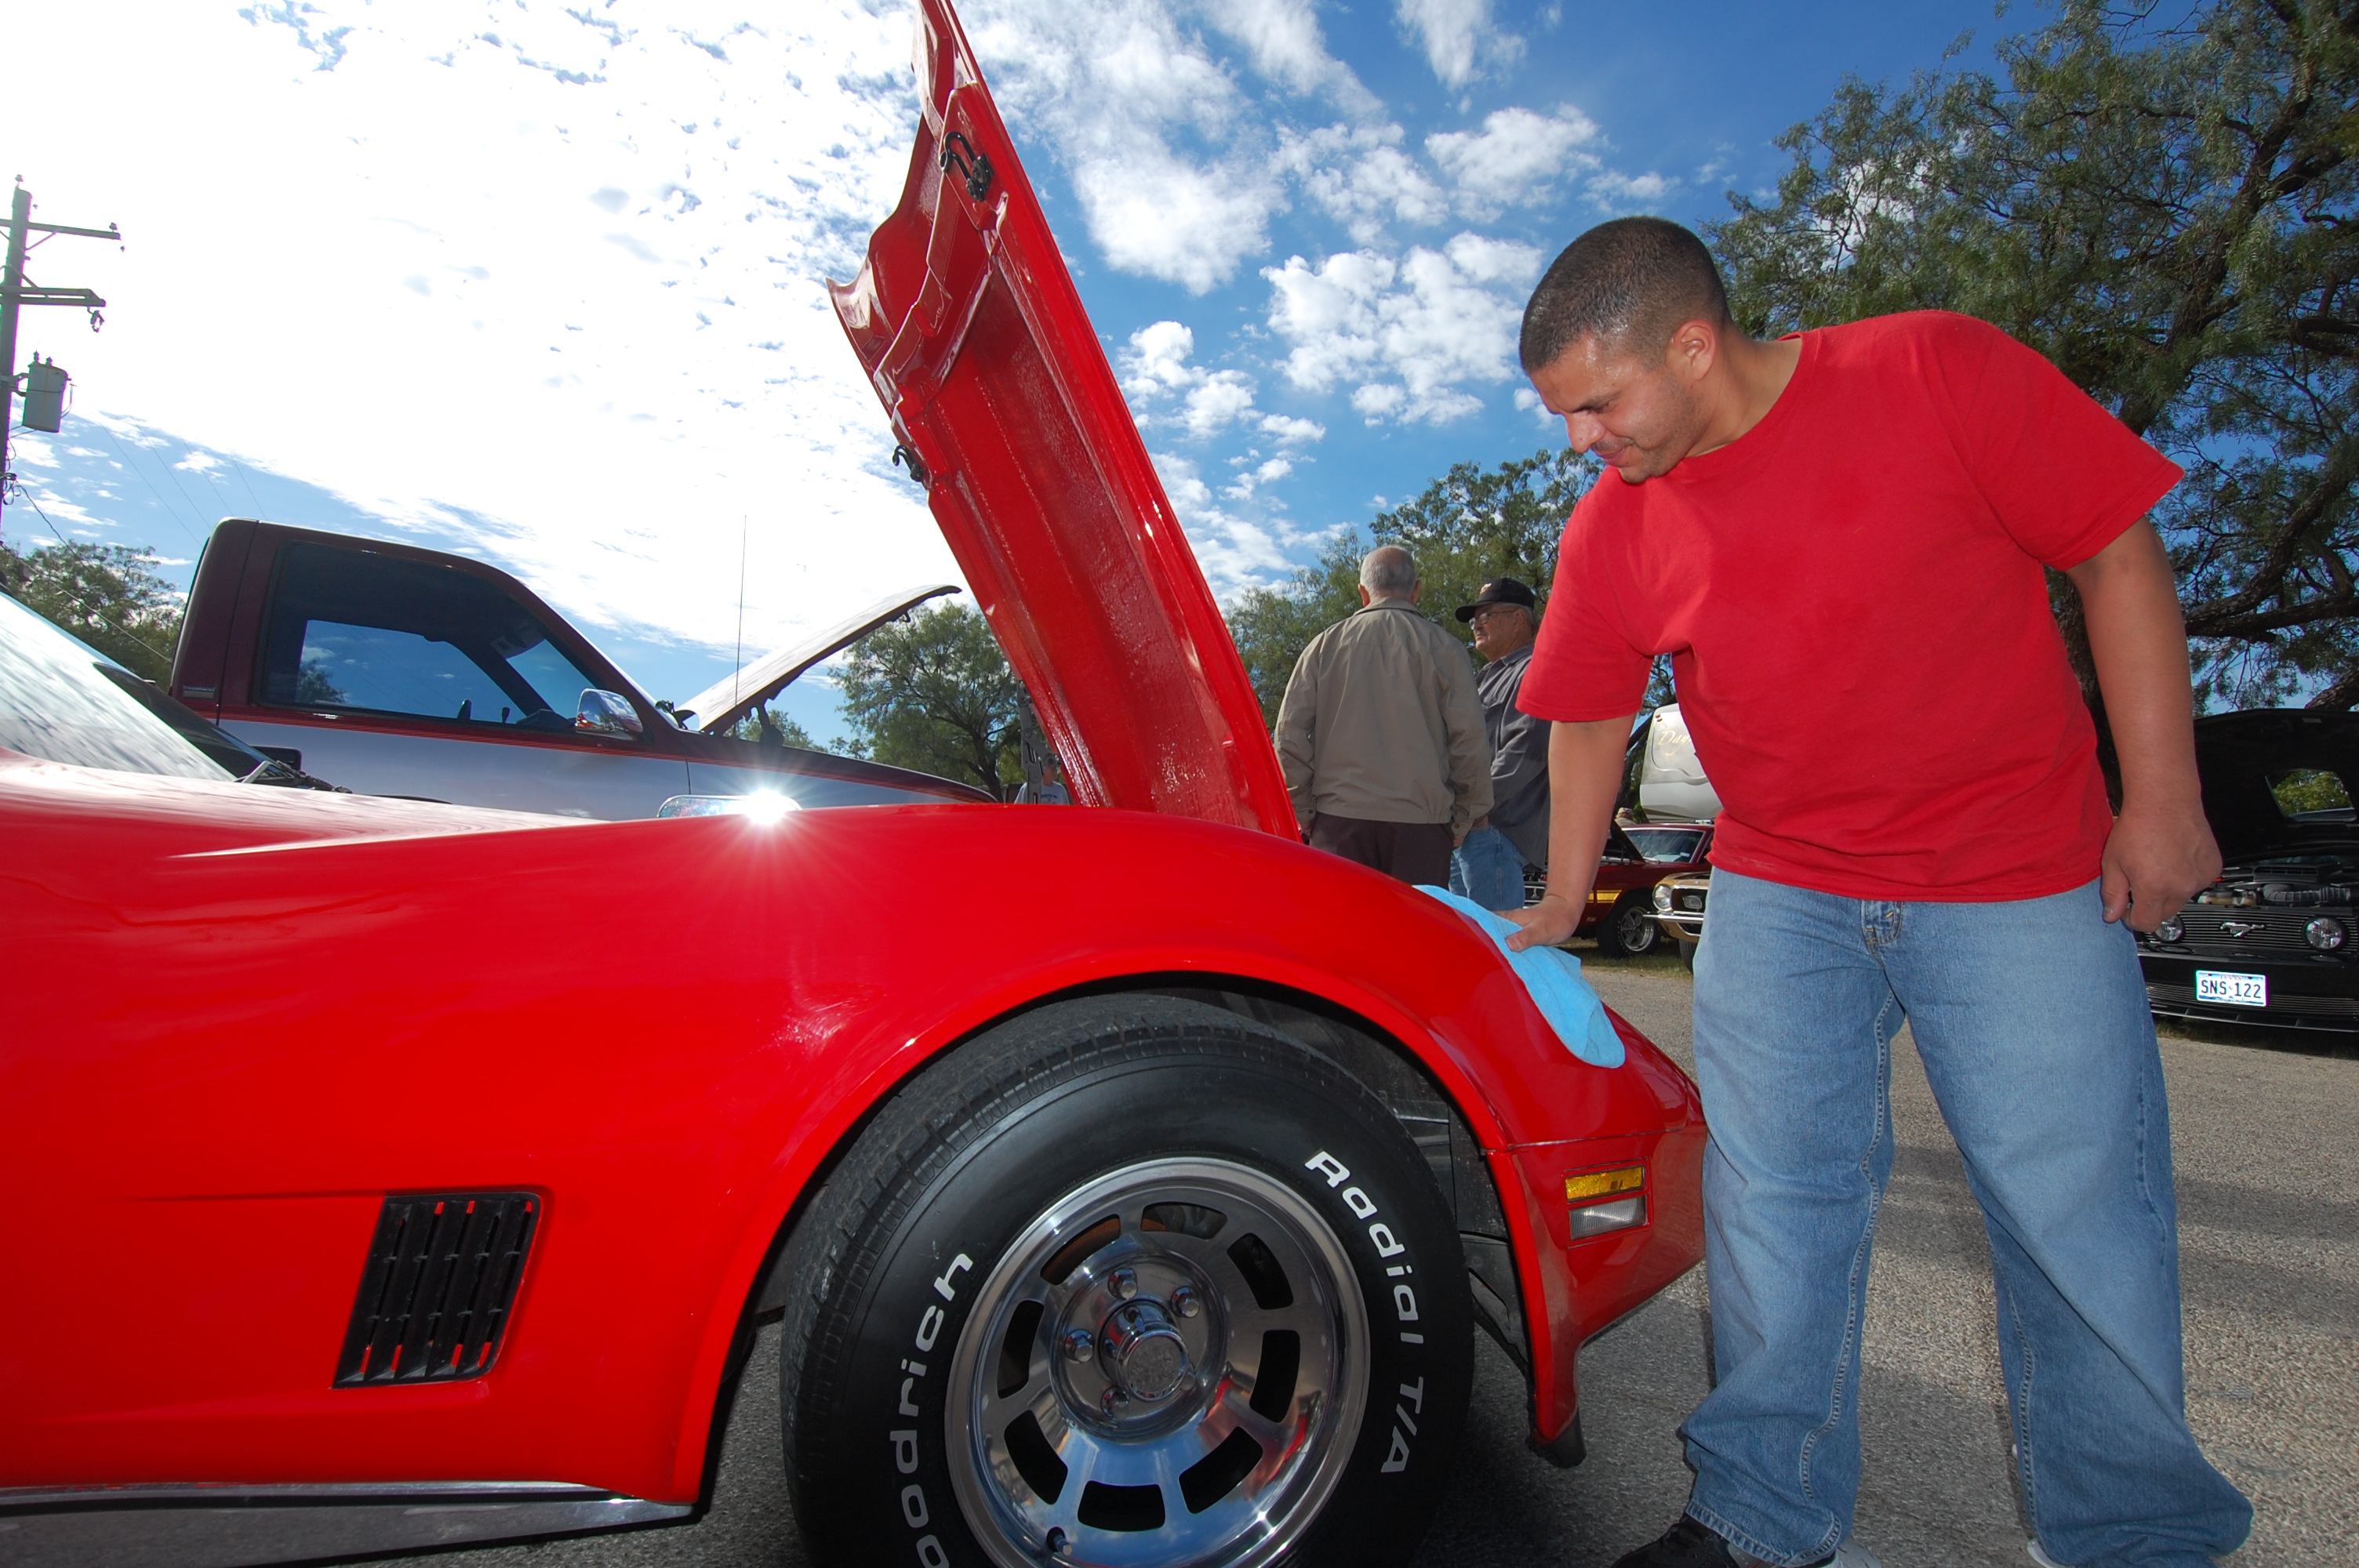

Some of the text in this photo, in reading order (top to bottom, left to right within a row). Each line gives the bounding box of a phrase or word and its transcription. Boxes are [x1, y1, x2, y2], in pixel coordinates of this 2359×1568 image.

[1658, 730, 1692, 757] Day
[1304, 1150, 1424, 1473] Radial T/A
